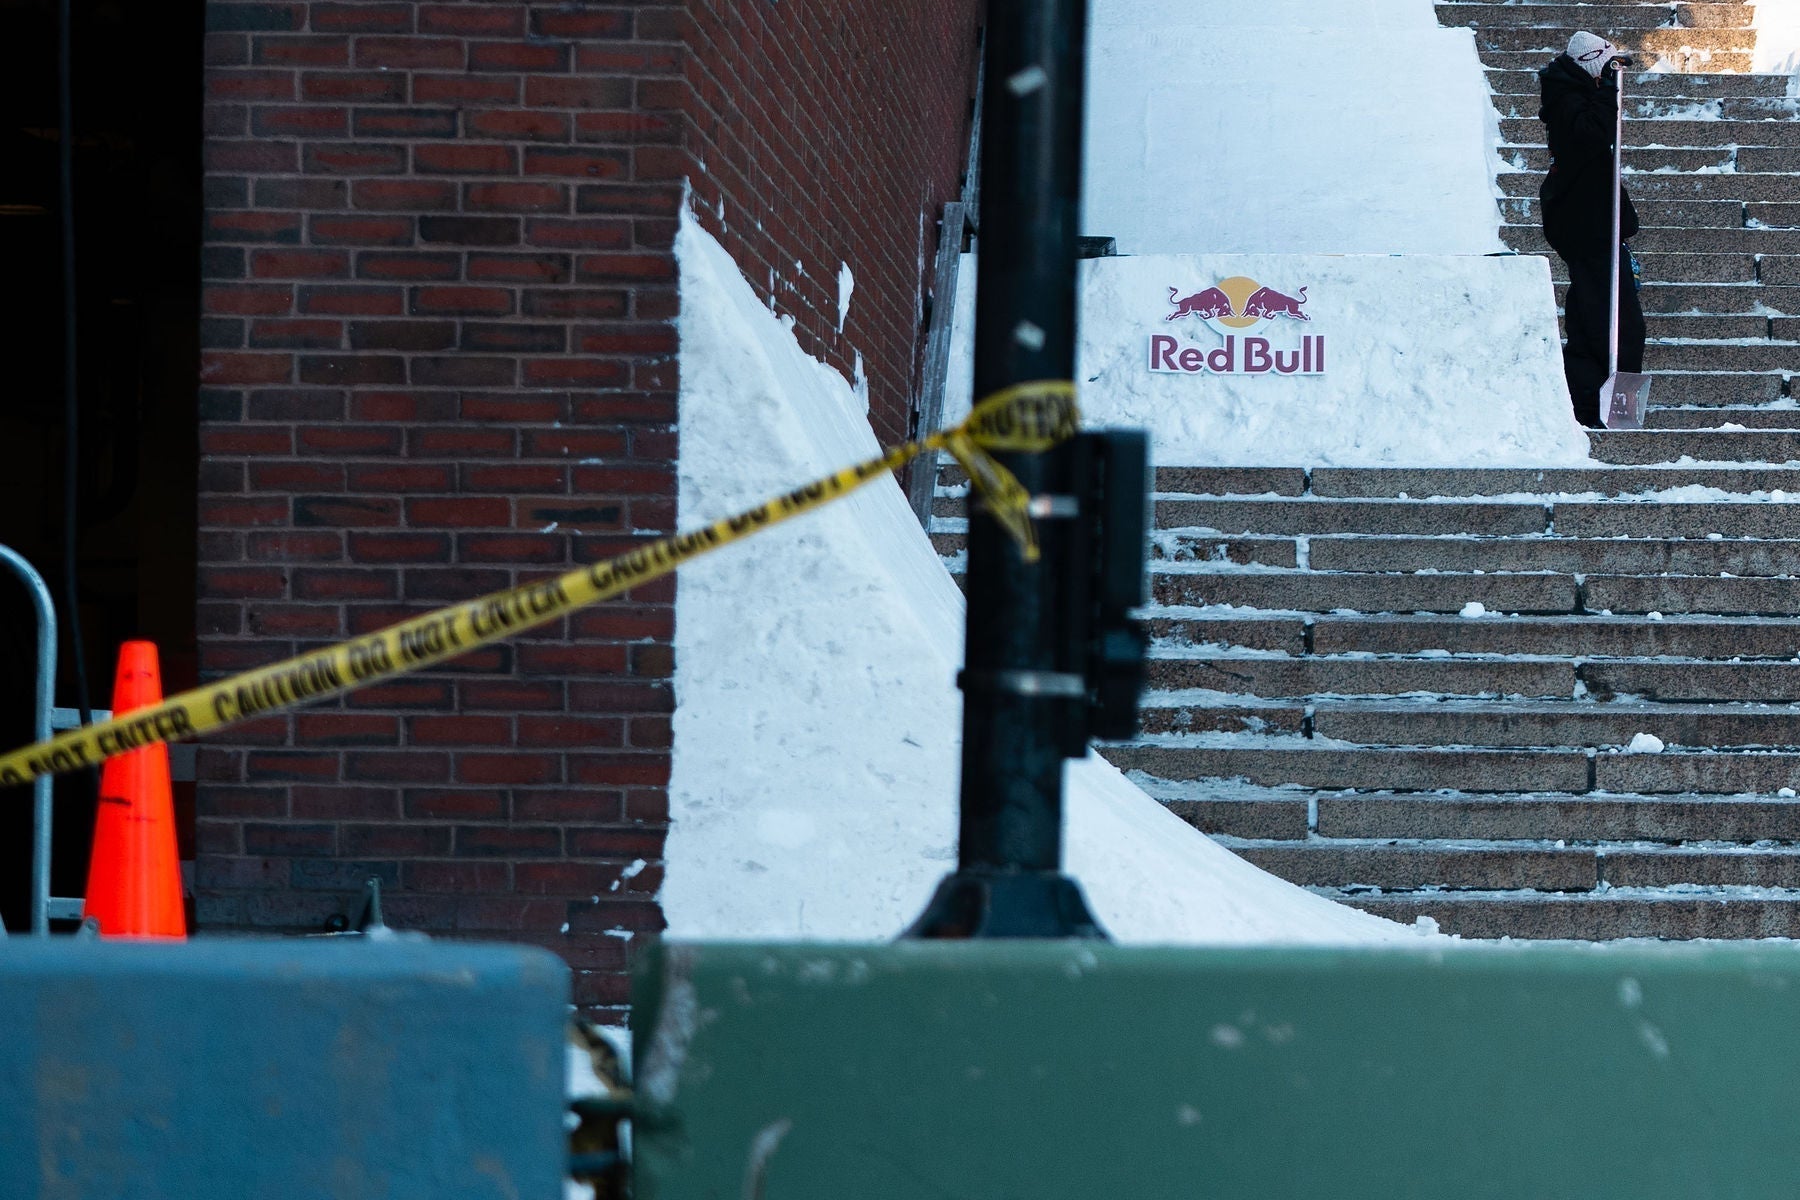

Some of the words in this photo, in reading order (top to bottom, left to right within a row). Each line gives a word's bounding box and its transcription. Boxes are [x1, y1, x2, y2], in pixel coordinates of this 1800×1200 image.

[1151, 335, 1234, 372] Red
[1243, 335, 1324, 373] Bull
[97, 704, 197, 754] ENTER
[212, 654, 341, 724] CAUTION
[347, 637, 393, 681] DO
[398, 614, 463, 663] NOT
